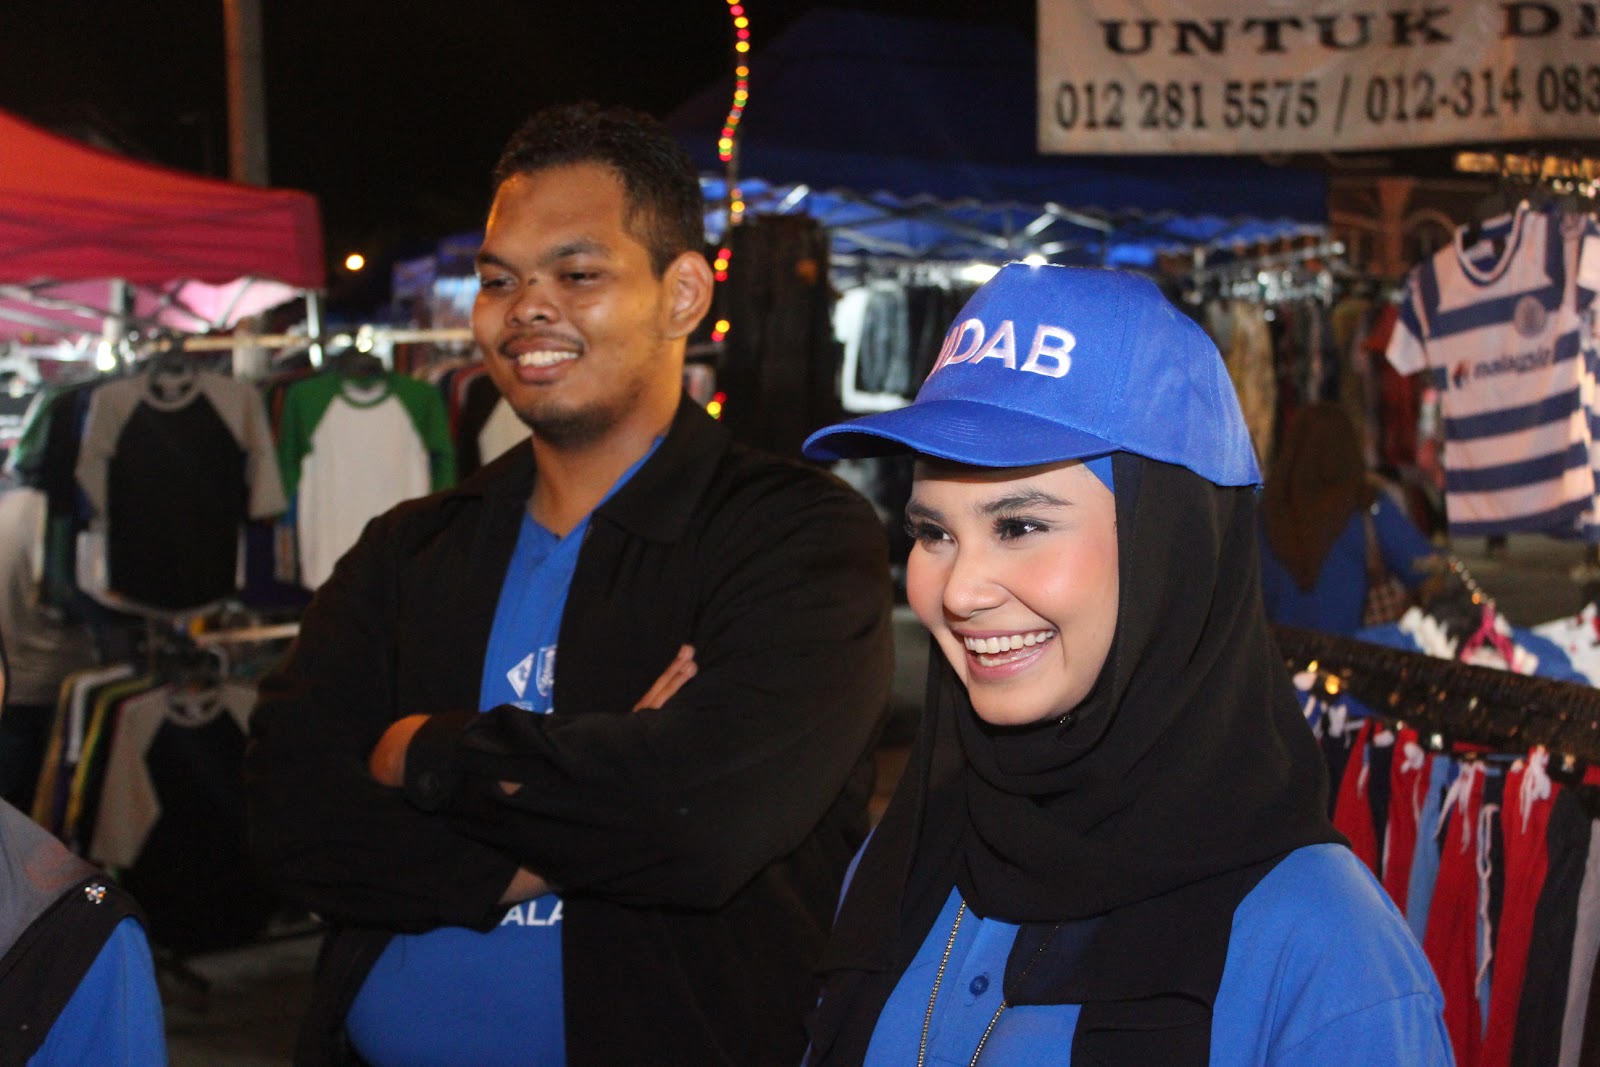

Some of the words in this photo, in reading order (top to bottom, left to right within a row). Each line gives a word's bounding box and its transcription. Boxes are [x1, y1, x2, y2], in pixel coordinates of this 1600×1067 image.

[1098, 7, 1452, 55] UNTUK
[1055, 80, 1124, 130] 012
[1138, 80, 1206, 130] 281
[1223, 80, 1319, 129] 5575
[1333, 74, 1352, 136] /
[1365, 67, 1523, 123] 012-314
